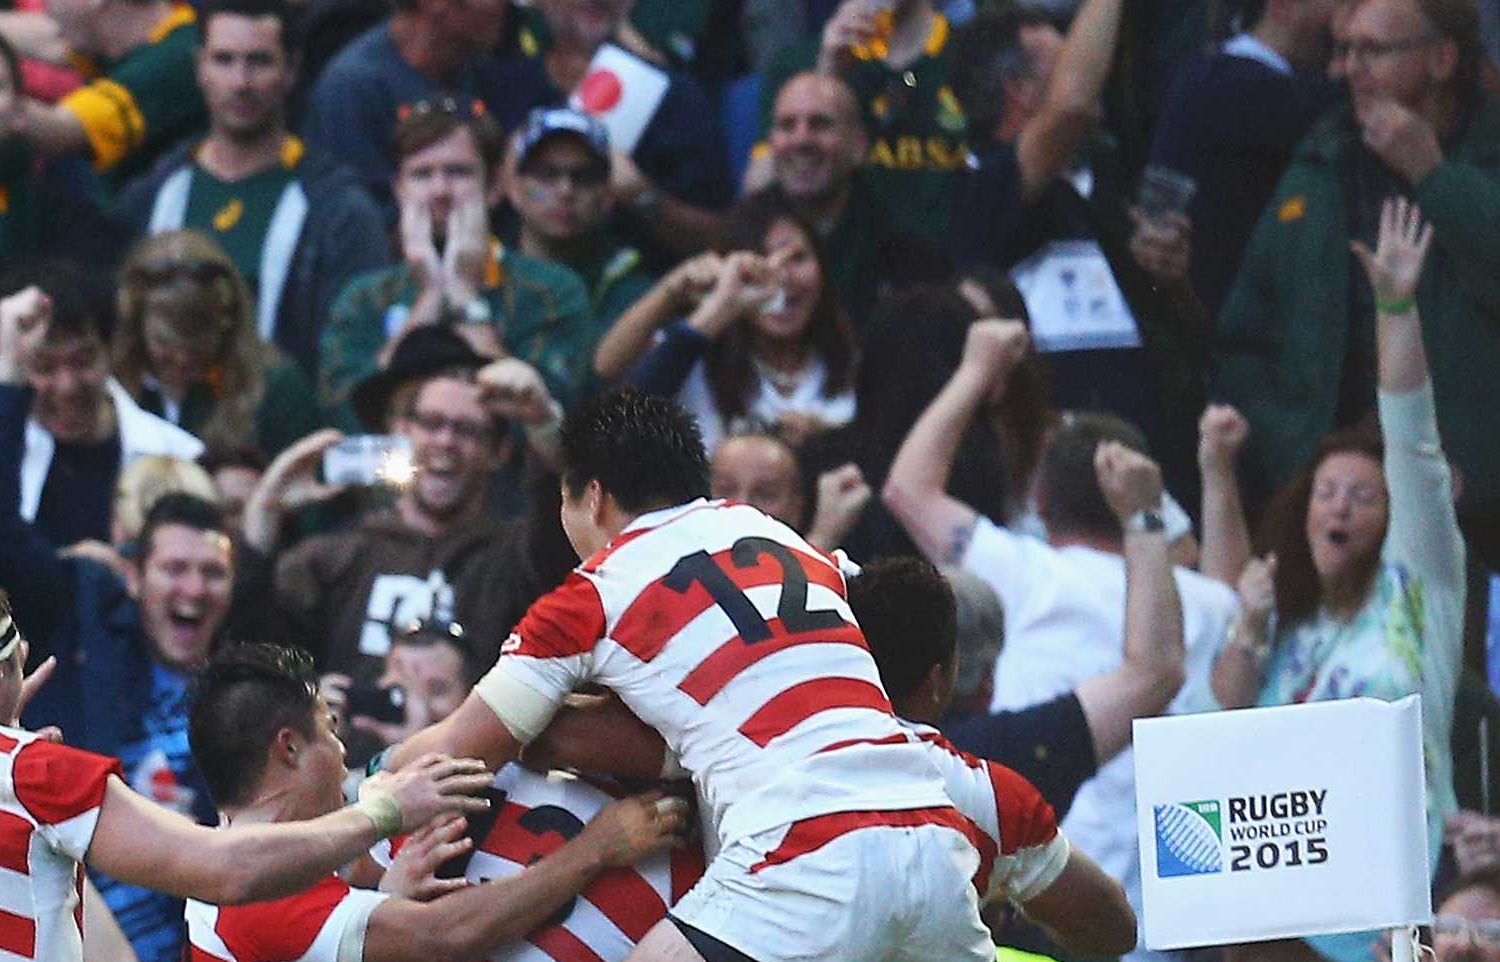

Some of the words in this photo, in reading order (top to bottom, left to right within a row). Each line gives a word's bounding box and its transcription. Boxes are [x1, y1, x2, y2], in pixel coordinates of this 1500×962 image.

[663, 536, 846, 645] 12
[1227, 789, 1328, 824] RUGBY
[1230, 822, 1291, 841] WORLD
[1294, 819, 1328, 837] CUP
[1230, 837, 1329, 872] 2015
